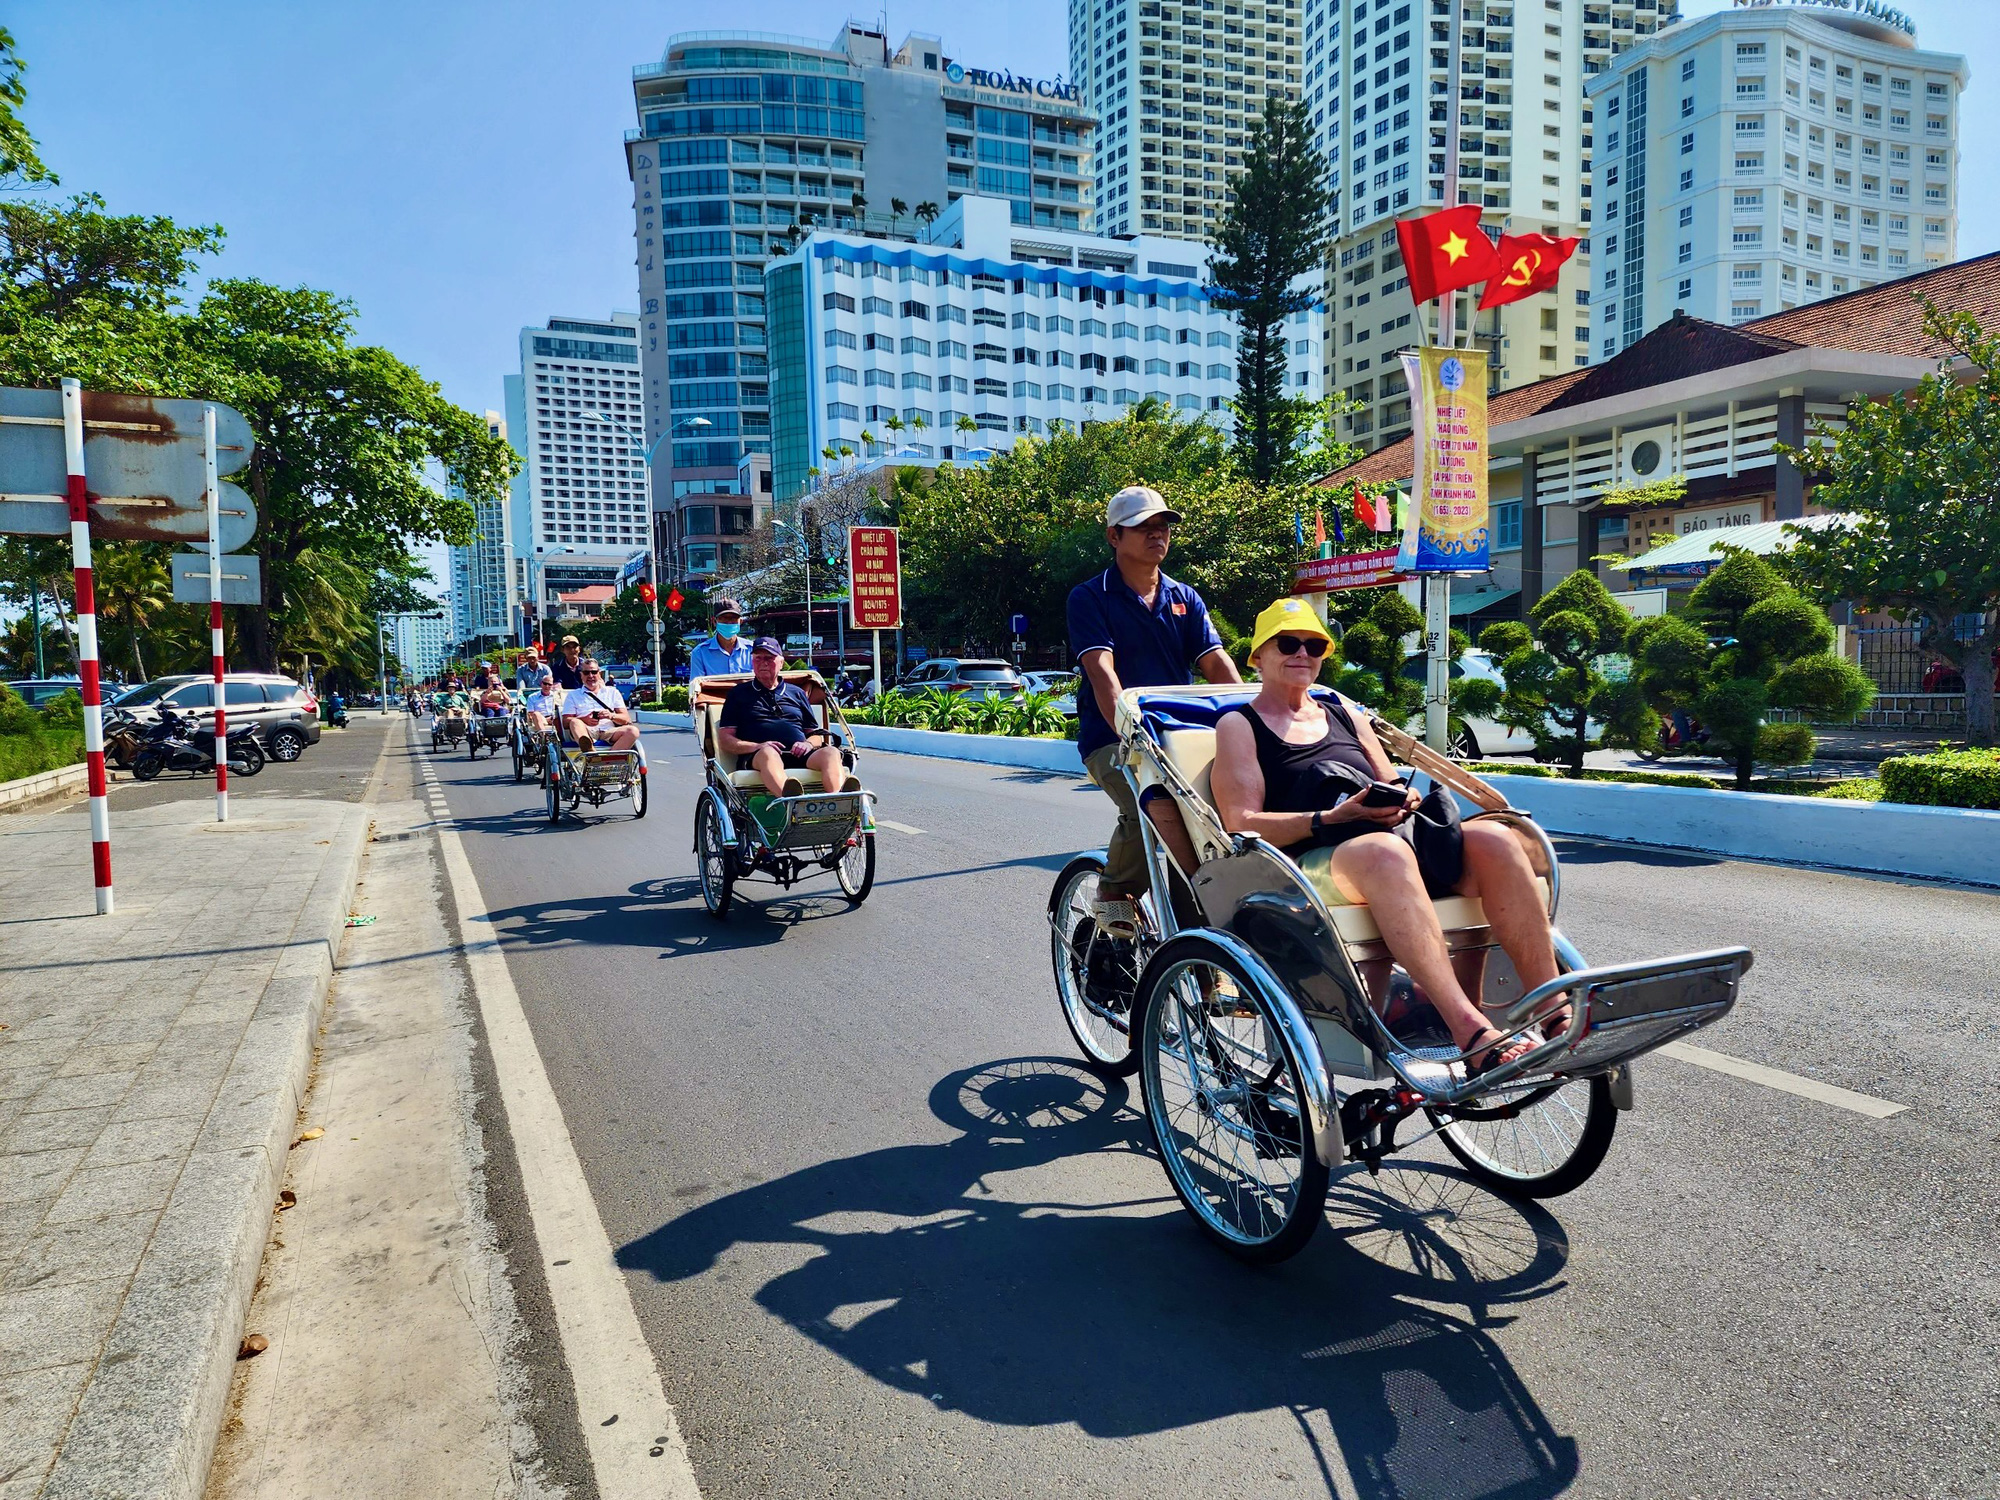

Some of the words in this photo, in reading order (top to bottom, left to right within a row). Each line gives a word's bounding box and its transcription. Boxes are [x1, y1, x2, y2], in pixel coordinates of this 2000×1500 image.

[970, 67, 1033, 94] HOÀN
[1036, 73, 1080, 101] CẦU
[637, 154, 655, 272] Diamond
[645, 299, 659, 352] Bay
[652, 379, 661, 438] HOTEL
[1716, 512, 1751, 528] TÀNG
[1429, 632, 1439, 640] 32
